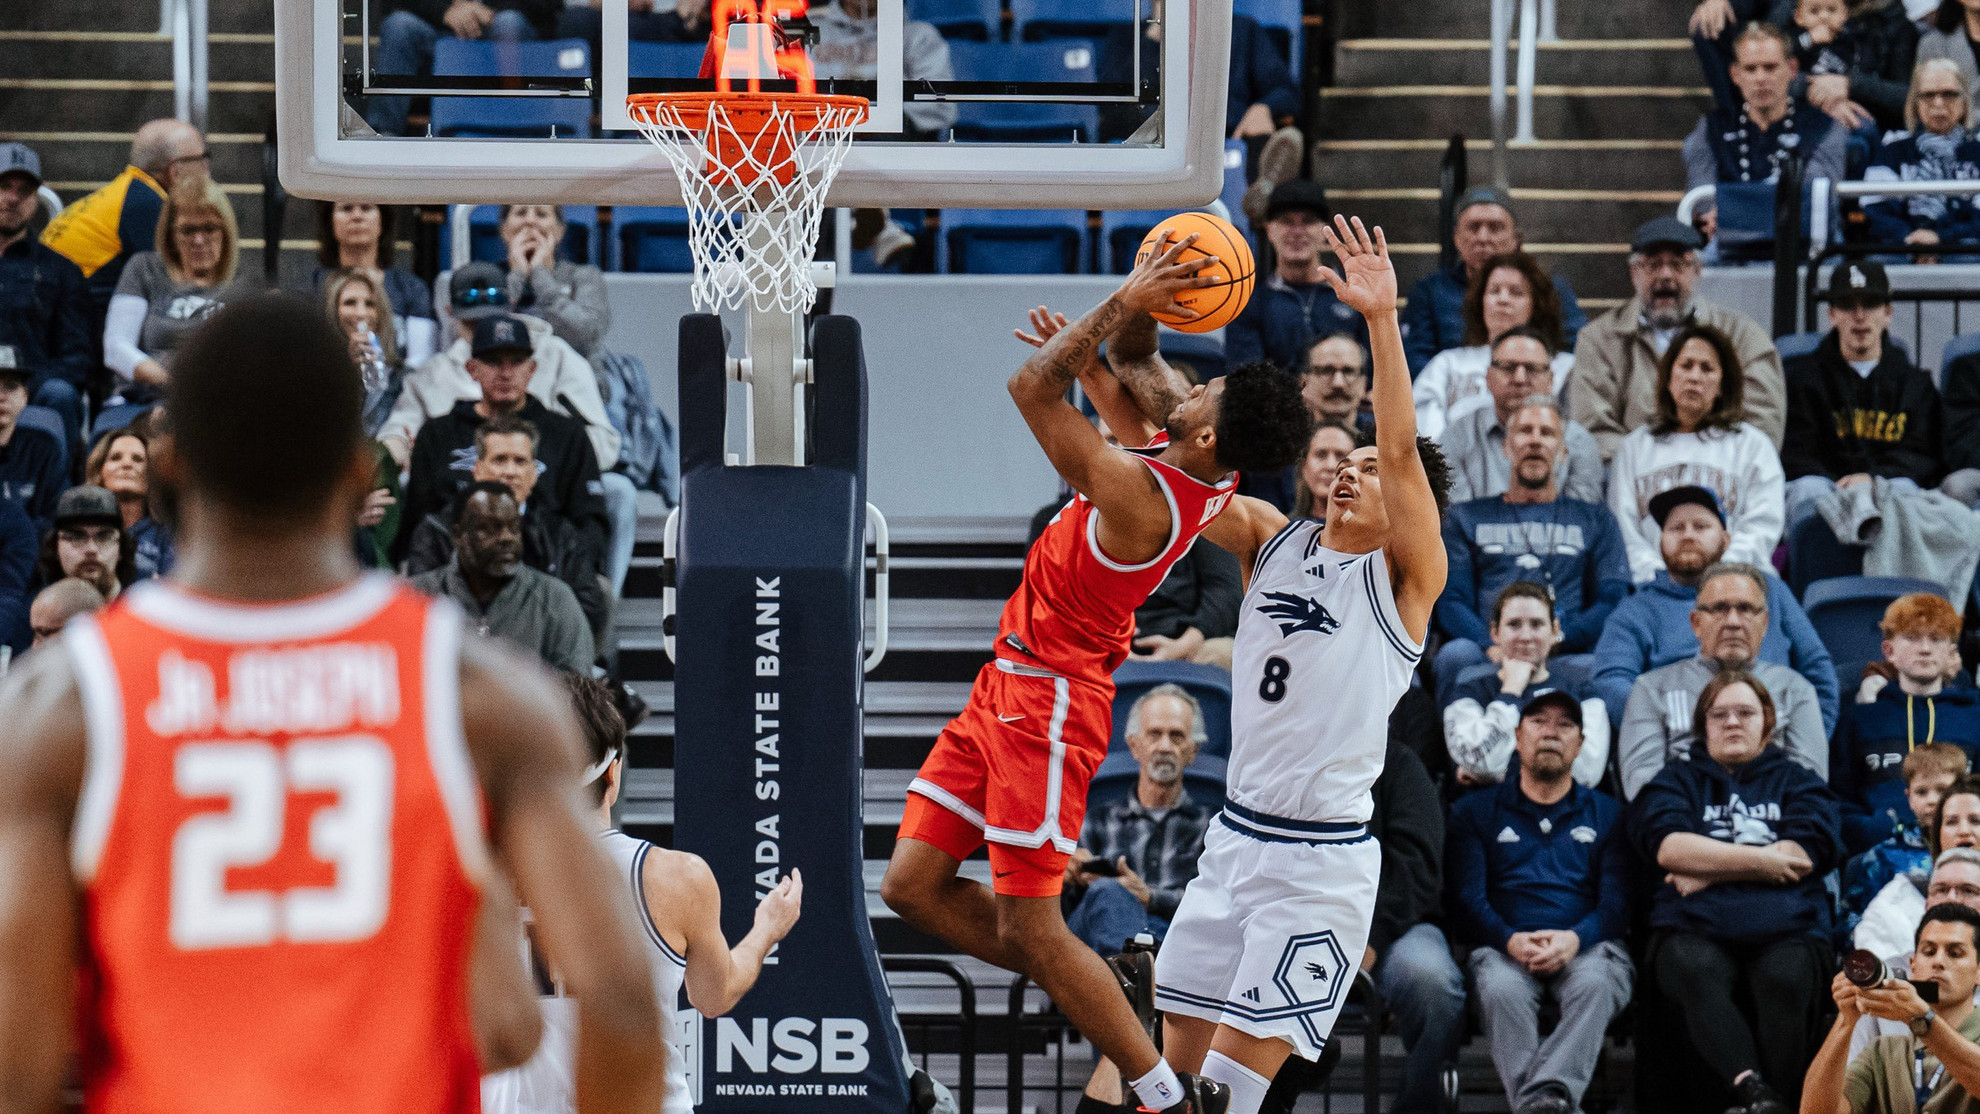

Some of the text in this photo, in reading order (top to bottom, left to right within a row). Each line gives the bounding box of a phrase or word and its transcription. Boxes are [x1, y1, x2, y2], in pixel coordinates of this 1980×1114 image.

[755, 576, 781, 677] BANK
[1258, 654, 1292, 704] 8
[755, 692, 780, 801] STATE
[169, 735, 396, 950] 23
[716, 1016, 871, 1075] NSB
[716, 1084, 868, 1096] NEVADA STATE BANK
